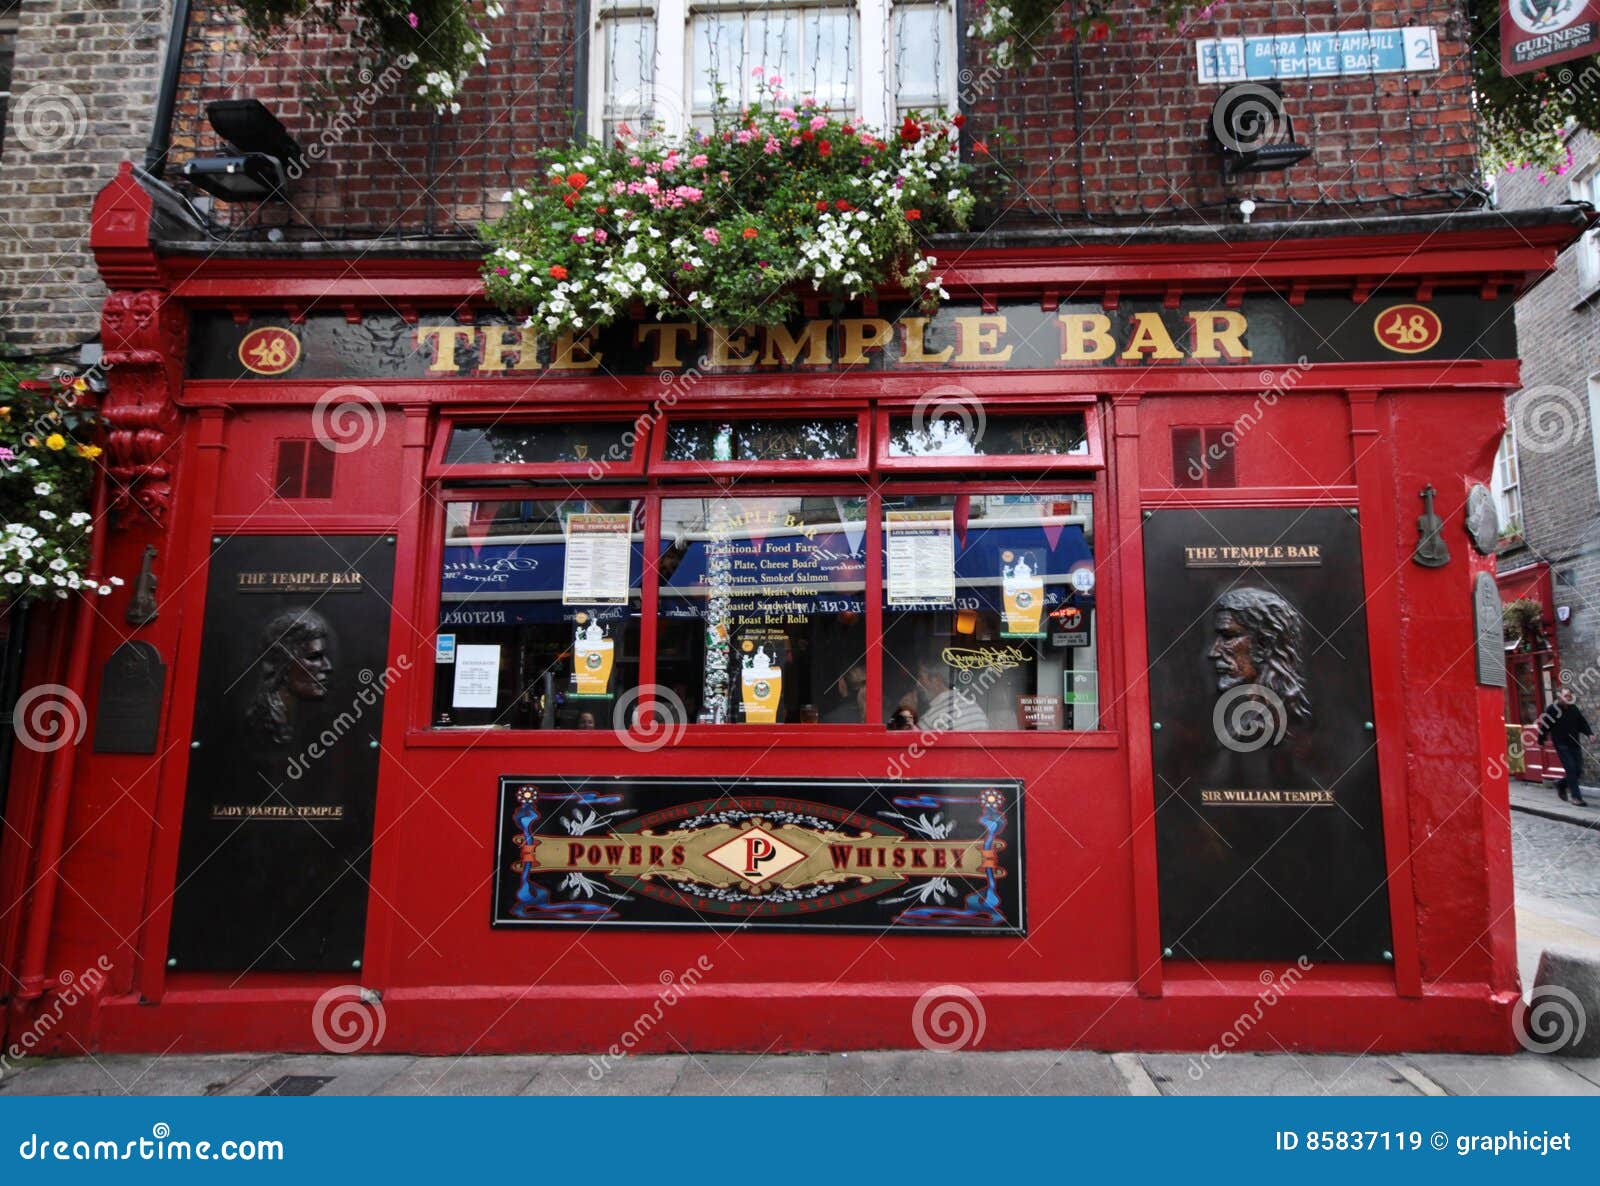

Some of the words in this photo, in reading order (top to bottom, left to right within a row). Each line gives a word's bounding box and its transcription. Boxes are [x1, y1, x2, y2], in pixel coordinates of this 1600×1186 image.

[1255, 40, 1297, 57] BARRA
[1304, 39, 1321, 54] AN
[1328, 35, 1394, 52] TEAMPAILL
[1515, 23, 1591, 53] GUINNESS
[1414, 39, 1432, 59] 2
[1527, 47, 1552, 60] good
[1554, 41, 1569, 50] for
[1270, 56, 1338, 73] TEMPLE
[1344, 53, 1380, 69] BAR
[1384, 312, 1429, 344] 48
[415, 324, 603, 373] THE
[637, 313, 1013, 369] TEMPLE
[1055, 309, 1254, 364] BAR
[248, 338, 286, 367] 48
[766, 543, 790, 553] Food
[795, 542, 818, 552] Fare
[1185, 547, 1217, 559] THE
[1220, 546, 1283, 558] TEMPLE
[1287, 545, 1320, 557] BAR
[734, 561, 757, 570] Plate,
[760, 560, 789, 569] Cheese
[792, 559, 818, 568] Board
[240, 573, 267, 584] THE
[271, 572, 328, 584] TEMPLE
[332, 572, 361, 584] BAR
[761, 573, 792, 583] Smoked
[797, 573, 829, 583] Salmon
[792, 588, 818, 597] Olives
[738, 615, 762, 625] Roast
[765, 614, 784, 624] Beef
[787, 613, 809, 624] Rolls
[1202, 791, 1220, 801] SIR
[1223, 791, 1280, 801] WILLIAM
[1282, 791, 1334, 801] TEMPLE
[212, 806, 242, 816] LADY
[246, 806, 293, 816] MARTHA
[298, 806, 343, 816] TEMPLE
[567, 842, 685, 867] POWERS
[828, 844, 965, 869] WHISKEY
